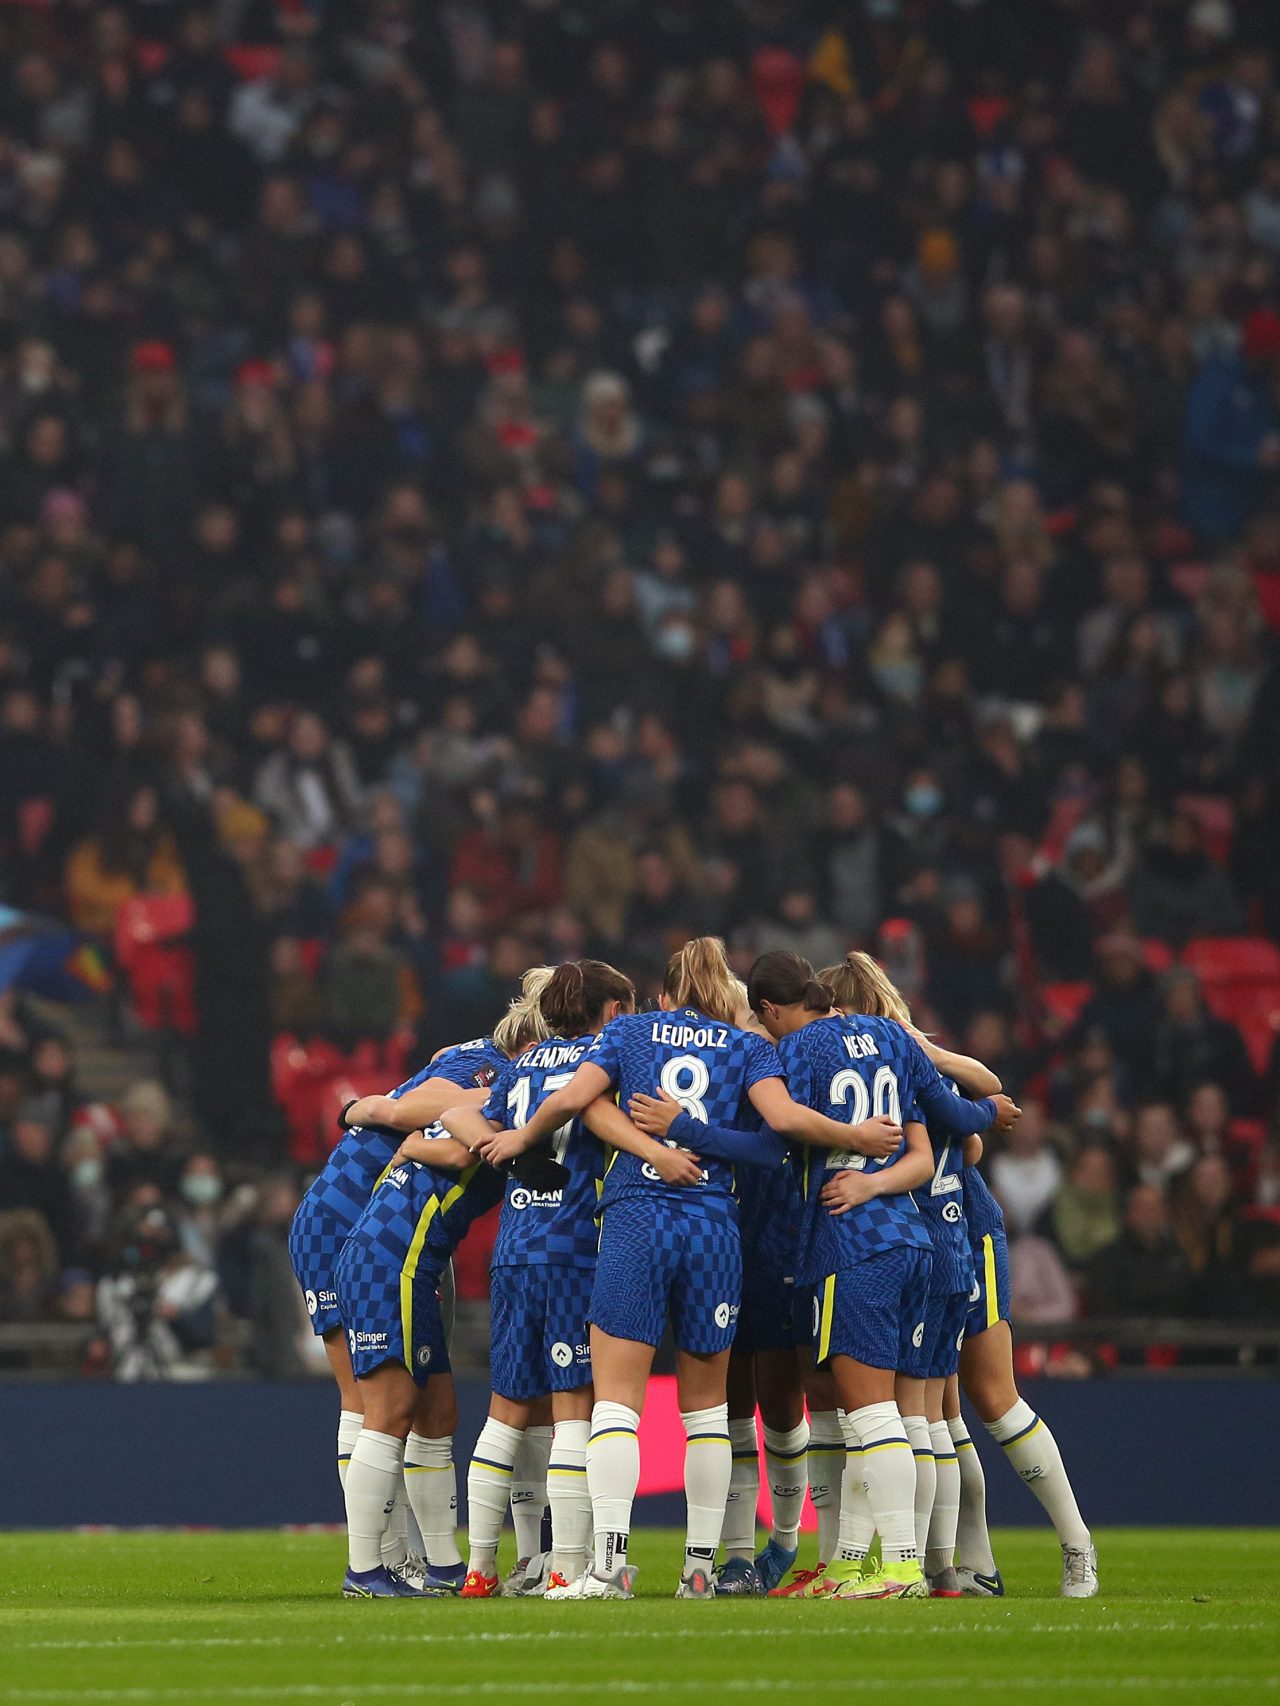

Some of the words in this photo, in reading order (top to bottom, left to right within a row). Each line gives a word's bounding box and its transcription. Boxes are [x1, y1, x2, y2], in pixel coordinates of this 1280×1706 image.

[651, 1022, 728, 1048] LEUPOLZ
[841, 1033, 879, 1058] KERR
[515, 1045, 585, 1069] FLEMING
[506, 1072, 577, 1166] 17
[826, 1065, 902, 1171] 20
[318, 1290, 337, 1302] Sin
[356, 1331, 388, 1344] Singer
[605, 1531, 614, 1572] PEDESIGN
